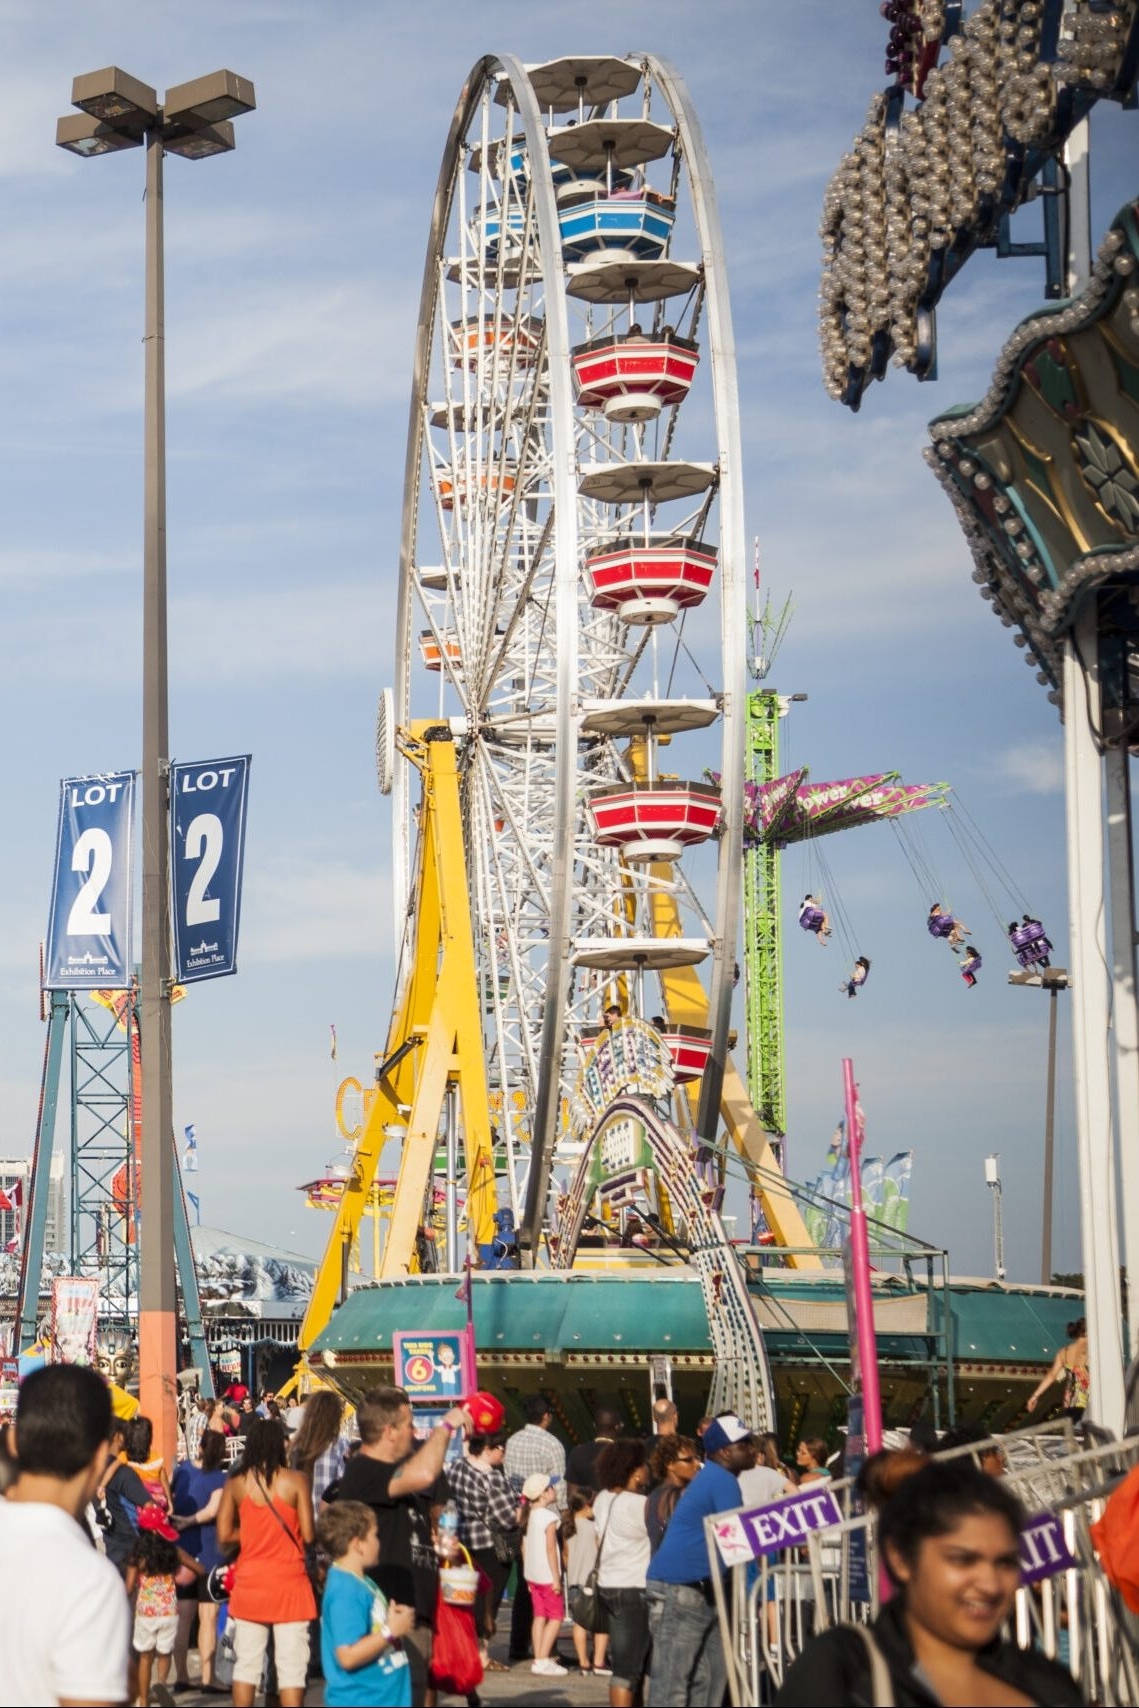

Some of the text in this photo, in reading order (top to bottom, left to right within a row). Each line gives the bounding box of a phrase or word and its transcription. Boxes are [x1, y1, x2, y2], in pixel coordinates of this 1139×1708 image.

[182, 768, 236, 793] LOT
[72, 783, 122, 808] LOT
[67, 828, 112, 936] 2
[183, 813, 223, 927] 2
[61, 967, 116, 976] Exhibition Place
[187, 953, 225, 968] Exhibition Place
[412, 1359, 427, 1380] 6
[749, 1496, 829, 1546] EXIT
[1020, 1521, 1063, 1572] IT
